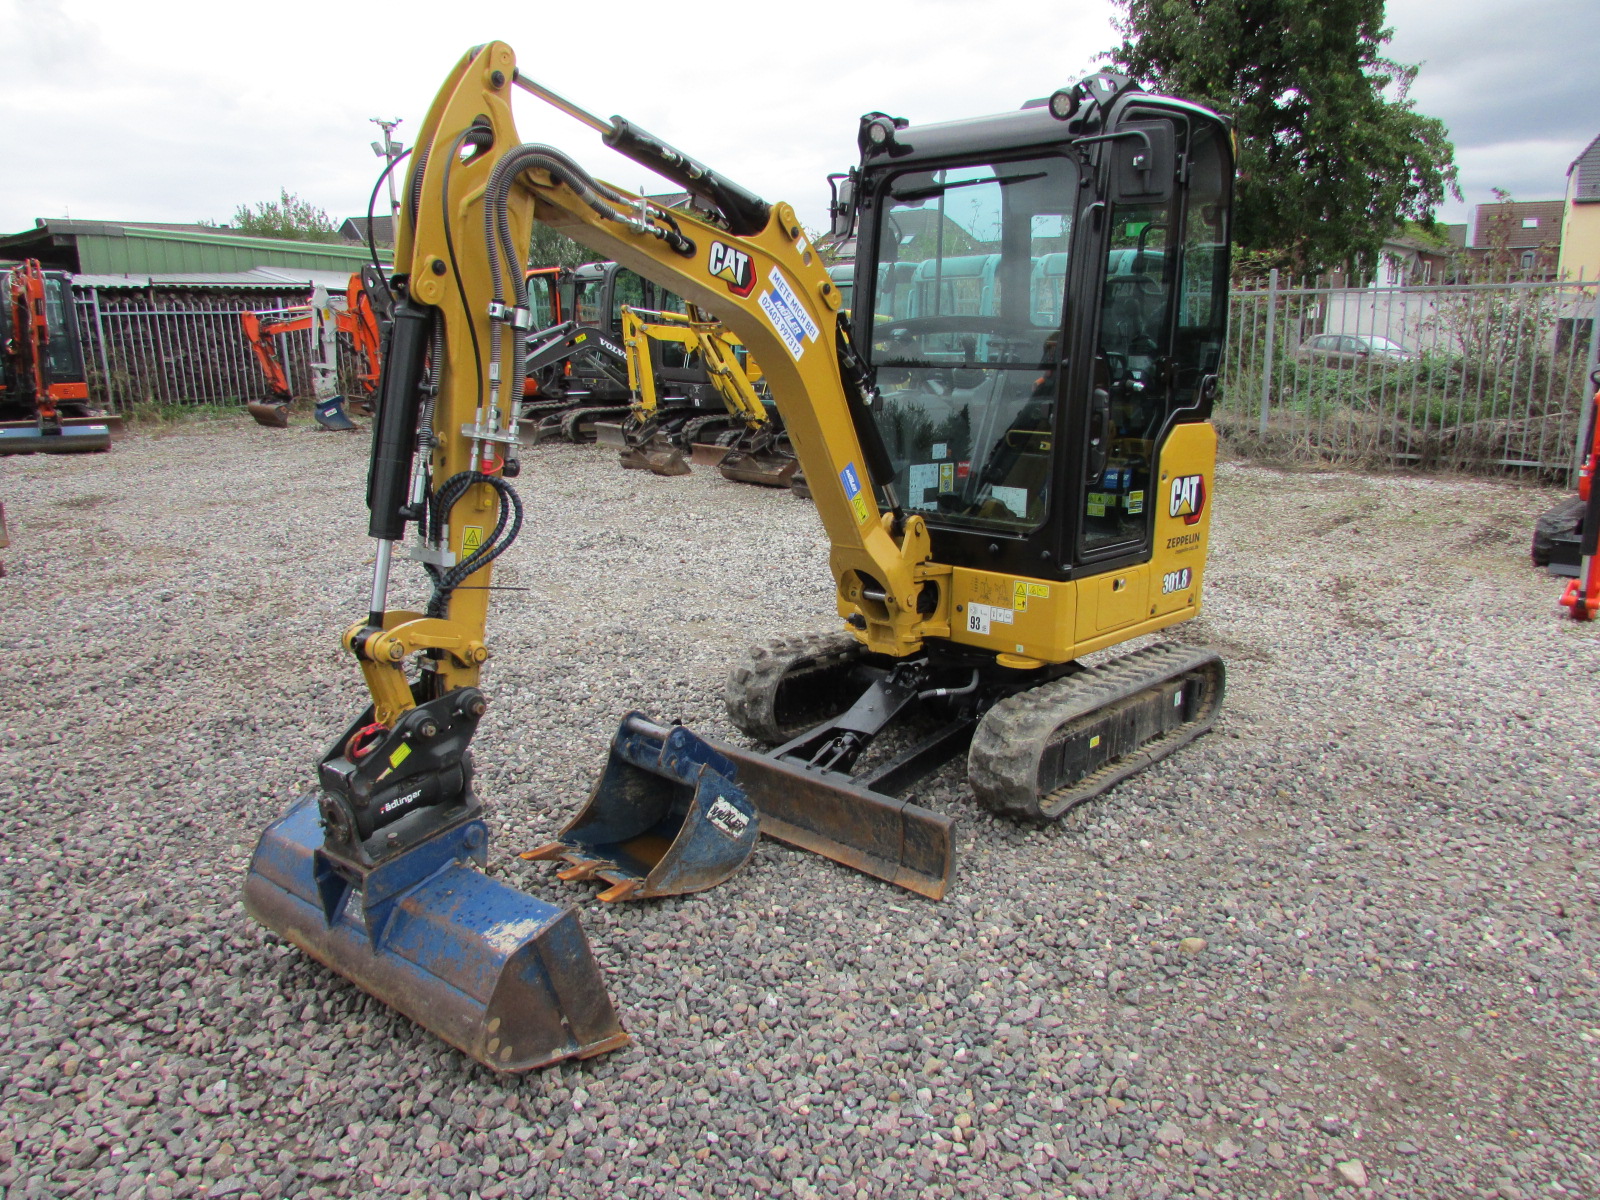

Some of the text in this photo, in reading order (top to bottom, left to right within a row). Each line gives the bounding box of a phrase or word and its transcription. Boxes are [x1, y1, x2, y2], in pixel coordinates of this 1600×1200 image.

[709, 241, 748, 286] CAT
[772, 272, 816, 338] MIETE MICH BEI
[762, 296, 801, 356] 02403 997312
[1170, 475, 1200, 517] CAT
[1166, 532, 1200, 549] ZEPPELIN
[1162, 568, 1188, 594] 301.8
[970, 615, 981, 630] 93
[380, 789, 422, 814] rädlinger
